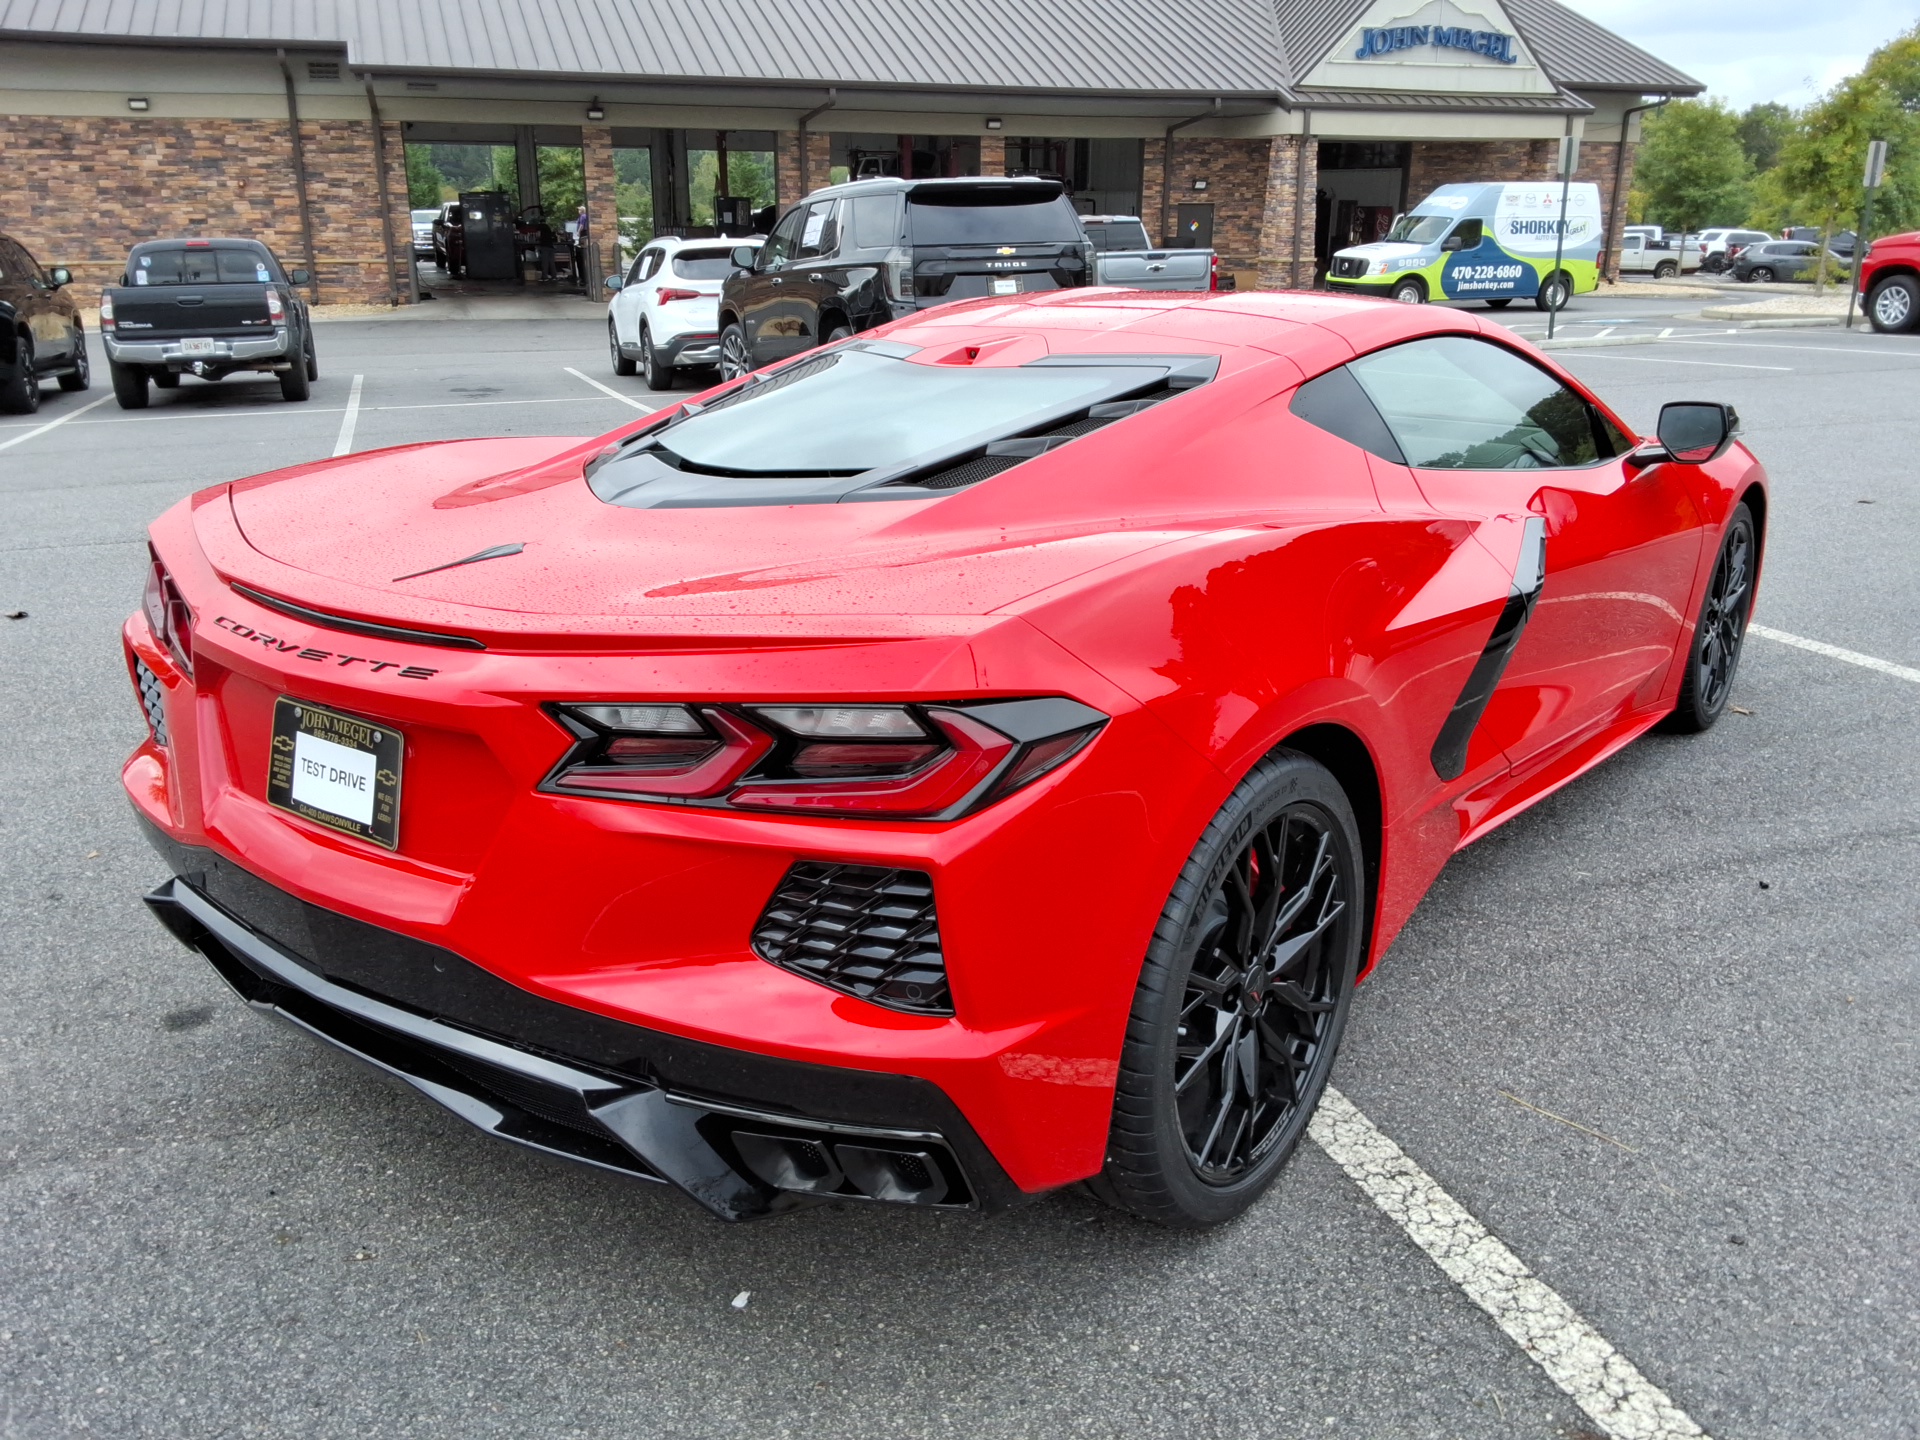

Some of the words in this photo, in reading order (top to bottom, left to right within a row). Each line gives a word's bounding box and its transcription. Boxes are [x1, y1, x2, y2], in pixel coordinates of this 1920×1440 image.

[1356, 25, 1431, 59] JOHN
[1431, 26, 1517, 64] MEGEL
[1452, 265, 1522, 279] 470-228-6860
[1457, 281, 1514, 292] jimshorkey.com
[213, 616, 439, 680] CORVETTE
[300, 709, 331, 730] JOHN
[332, 718, 374, 749] MEGEL
[313, 728, 358, 749] 866-778-3334
[301, 757, 326, 779] TEST
[329, 768, 366, 792] DRIVE
[317, 810, 361, 832] DAWSONVILLE
[1195, 818, 1251, 919] MICHELIN
